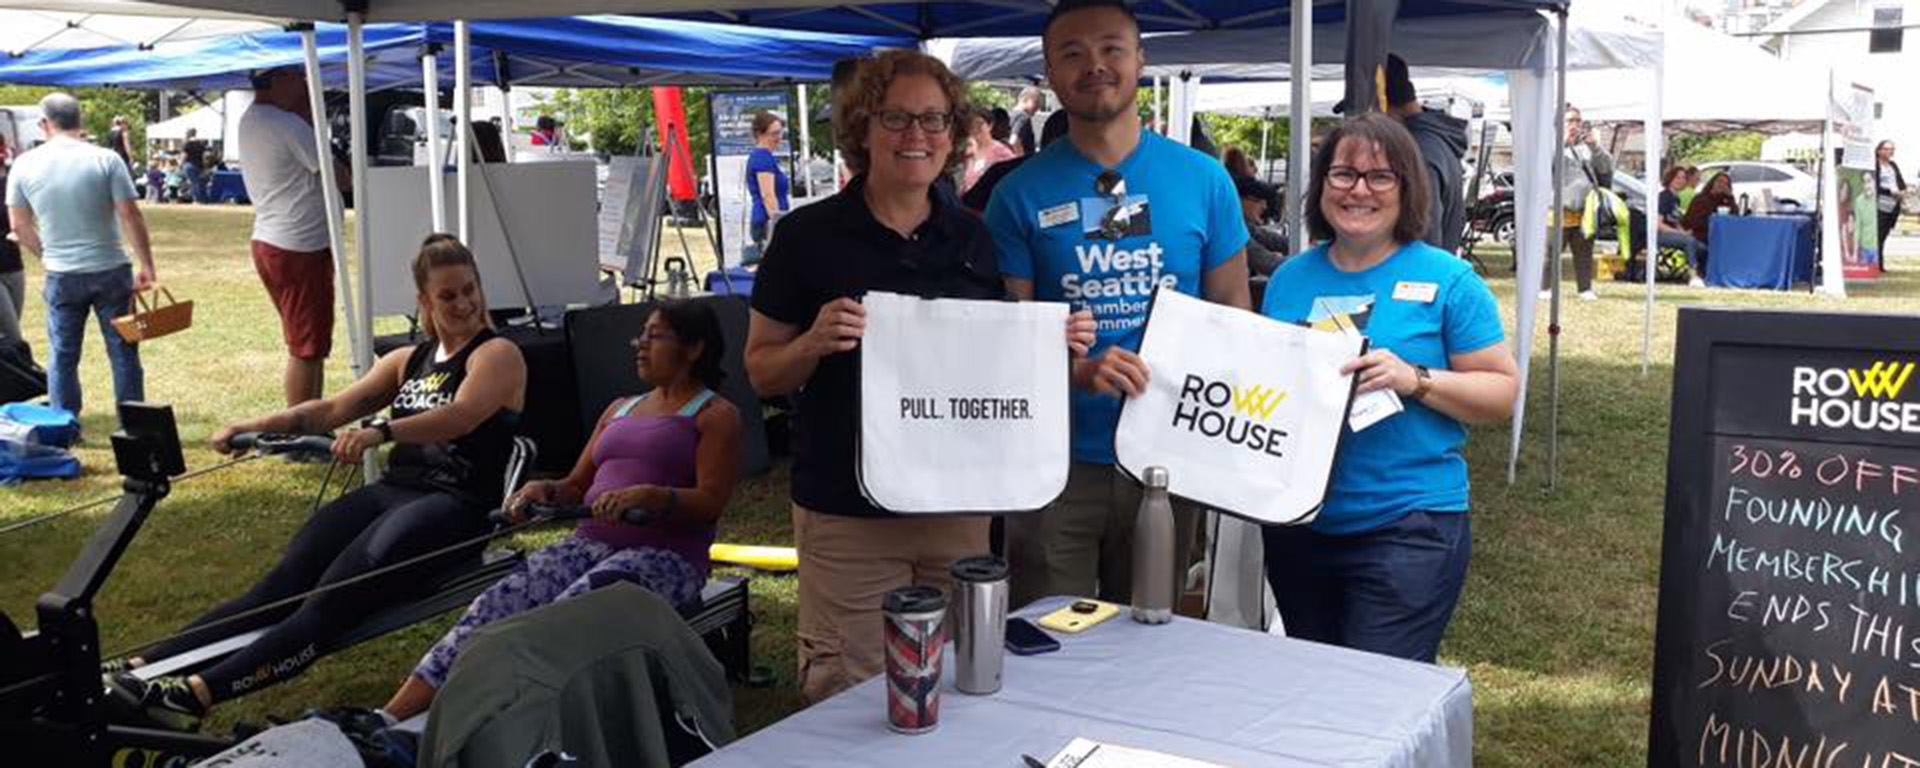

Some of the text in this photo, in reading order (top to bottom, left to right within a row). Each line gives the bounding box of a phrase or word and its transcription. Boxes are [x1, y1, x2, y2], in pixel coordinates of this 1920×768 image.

[1075, 242, 1163, 273] West
[1061, 268, 1178, 298] Seattle
[394, 392, 452, 408] COACH
[900, 398, 1033, 419] PULL. TOGETHER.
[1791, 397, 1920, 433] HOUSE
[1172, 402, 1288, 457] HOUSE
[1730, 445, 1920, 494] 30% OFF
[1725, 486, 1903, 554] FOUNDING
[1727, 592, 1920, 667] ENDS THIS
[1698, 638, 1920, 722] SUNDAY AT
